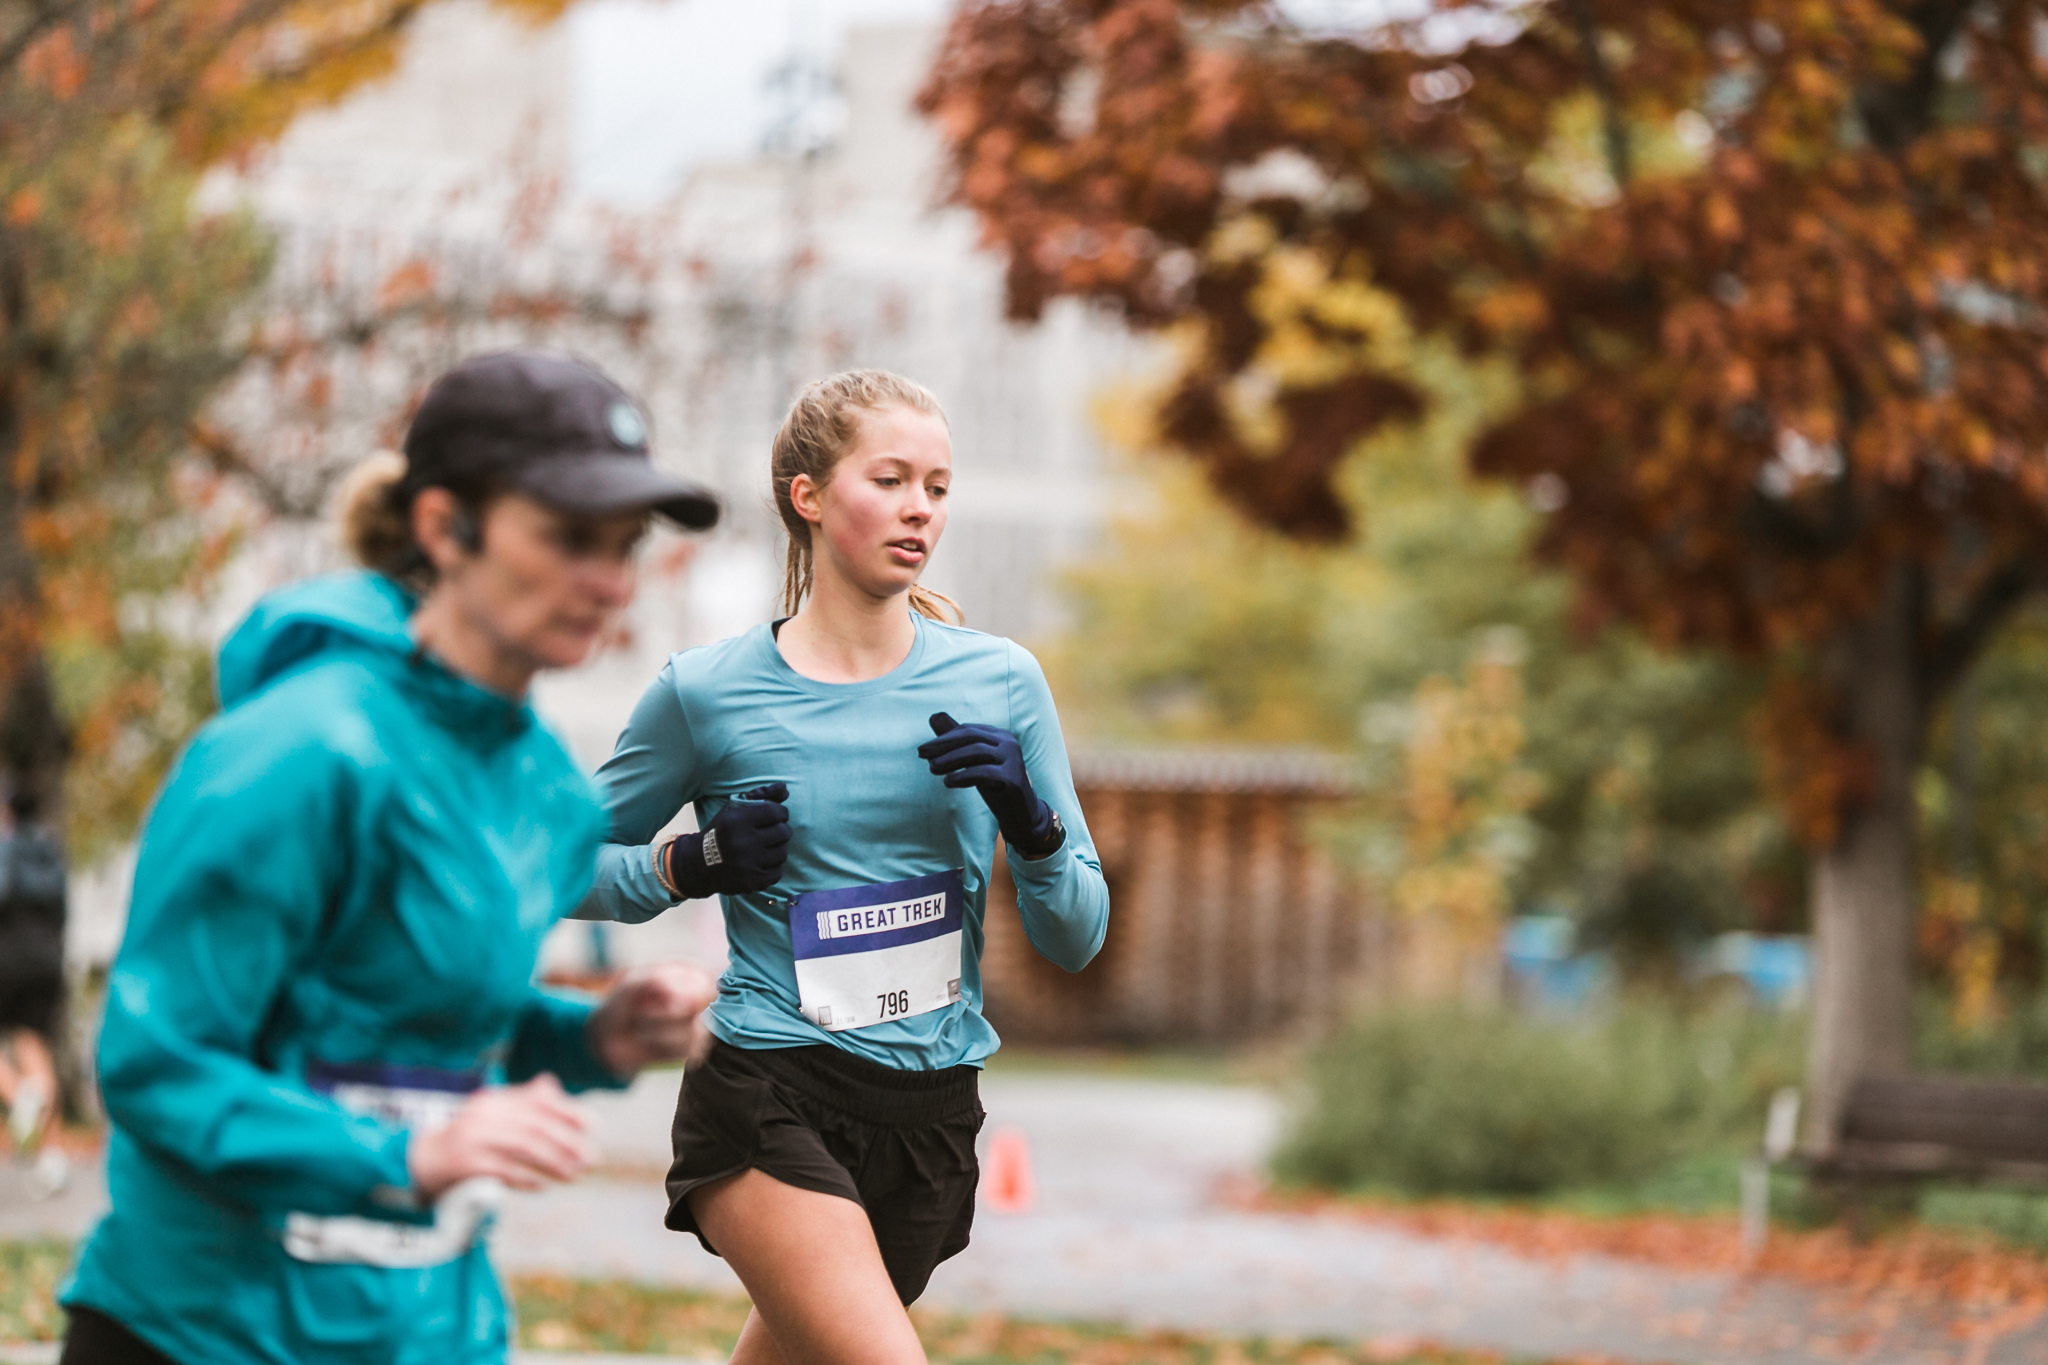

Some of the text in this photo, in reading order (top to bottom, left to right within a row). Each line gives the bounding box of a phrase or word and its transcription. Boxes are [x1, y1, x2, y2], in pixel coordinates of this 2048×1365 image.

[837, 897, 942, 932] GREAT TREK
[877, 989, 909, 1019] 796
